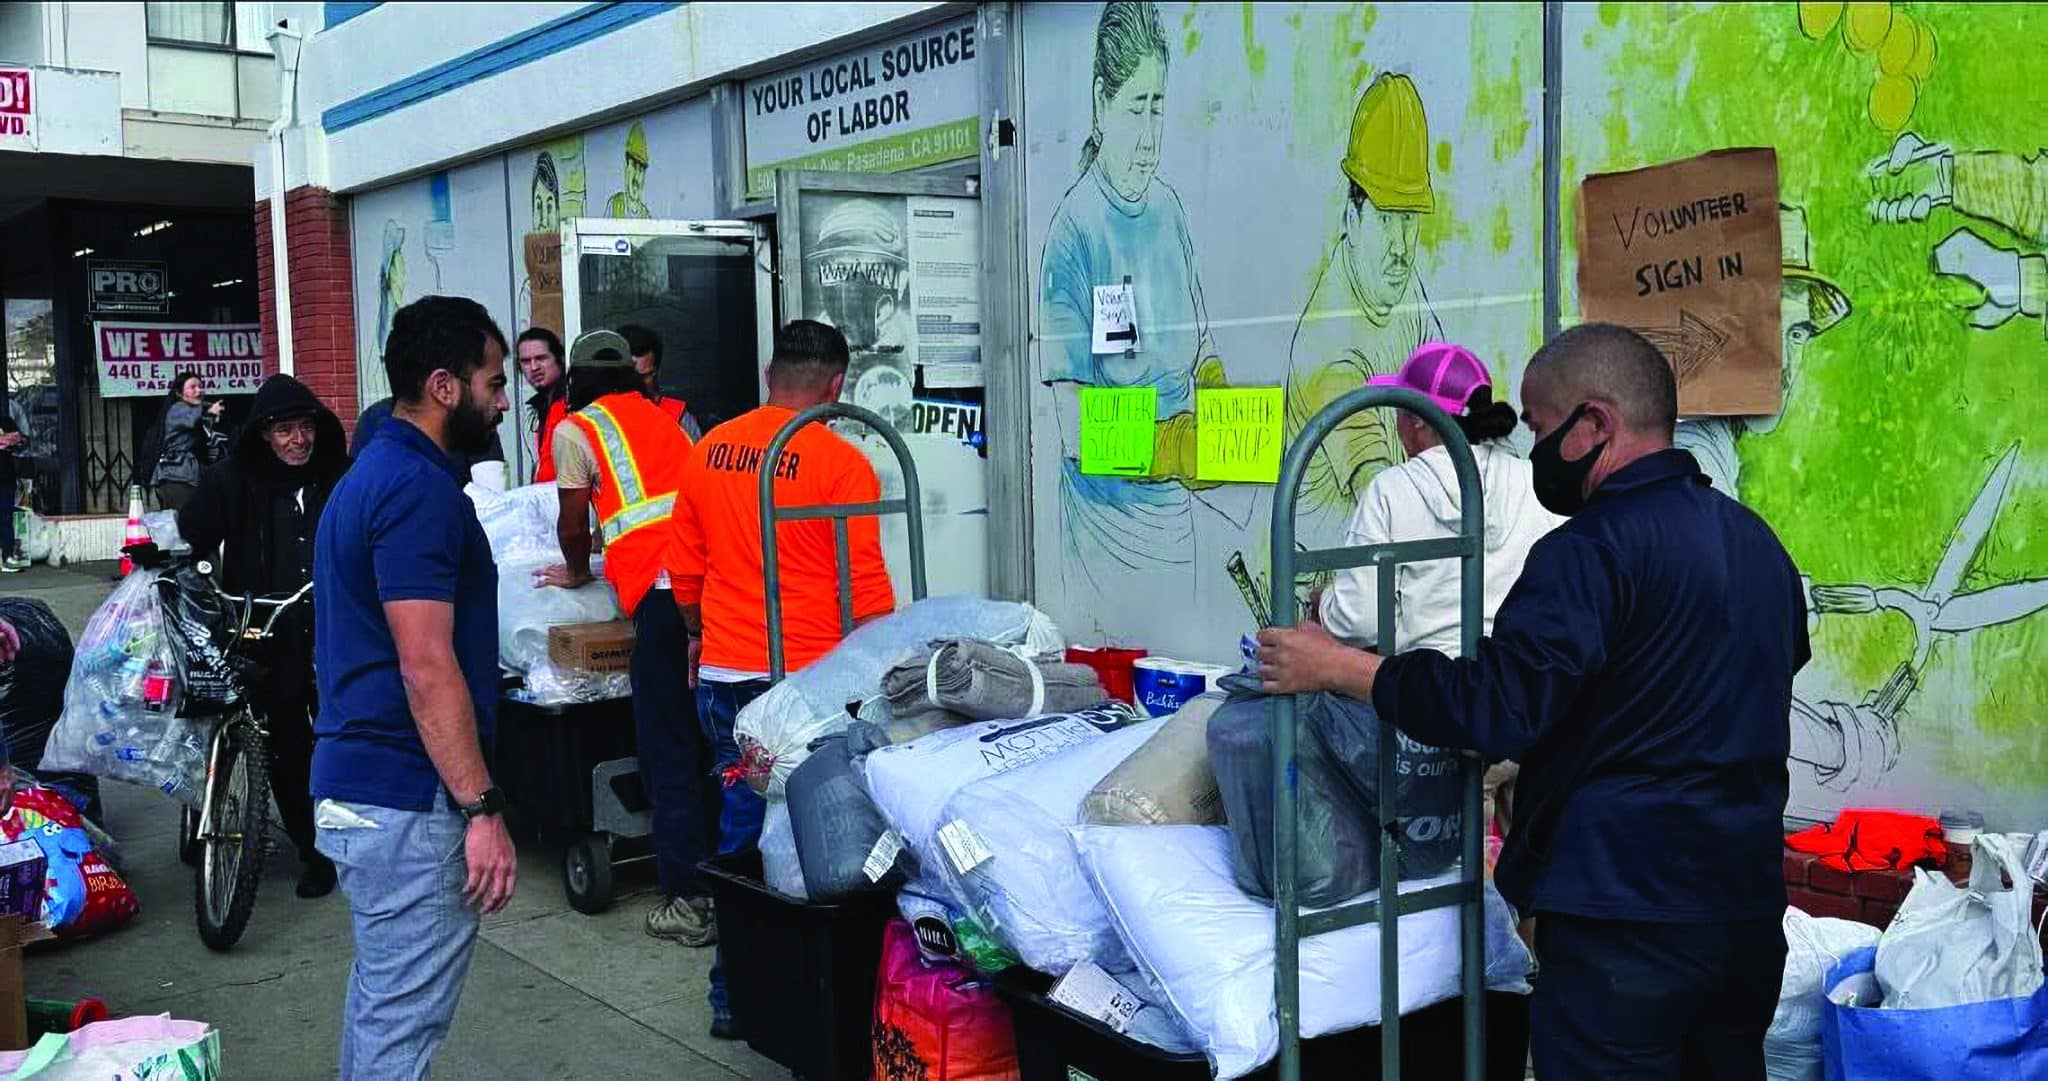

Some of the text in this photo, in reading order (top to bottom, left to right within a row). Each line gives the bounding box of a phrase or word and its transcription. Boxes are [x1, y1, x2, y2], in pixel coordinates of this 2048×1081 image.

[752, 26, 976, 116] YOUR LOCAL SOURCE
[806, 90, 911, 143] OF LABOR
[911, 134, 931, 158] CA
[1612, 192, 1749, 250] VOLUNTEER
[1635, 252, 1744, 297] SIGN IN
[106, 331, 151, 358] WE
[160, 331, 195, 358] VE
[108, 362, 261, 379] 440 E. COLORADO
[228, 379, 247, 388] CA
[705, 443, 800, 480] VOLUNER
